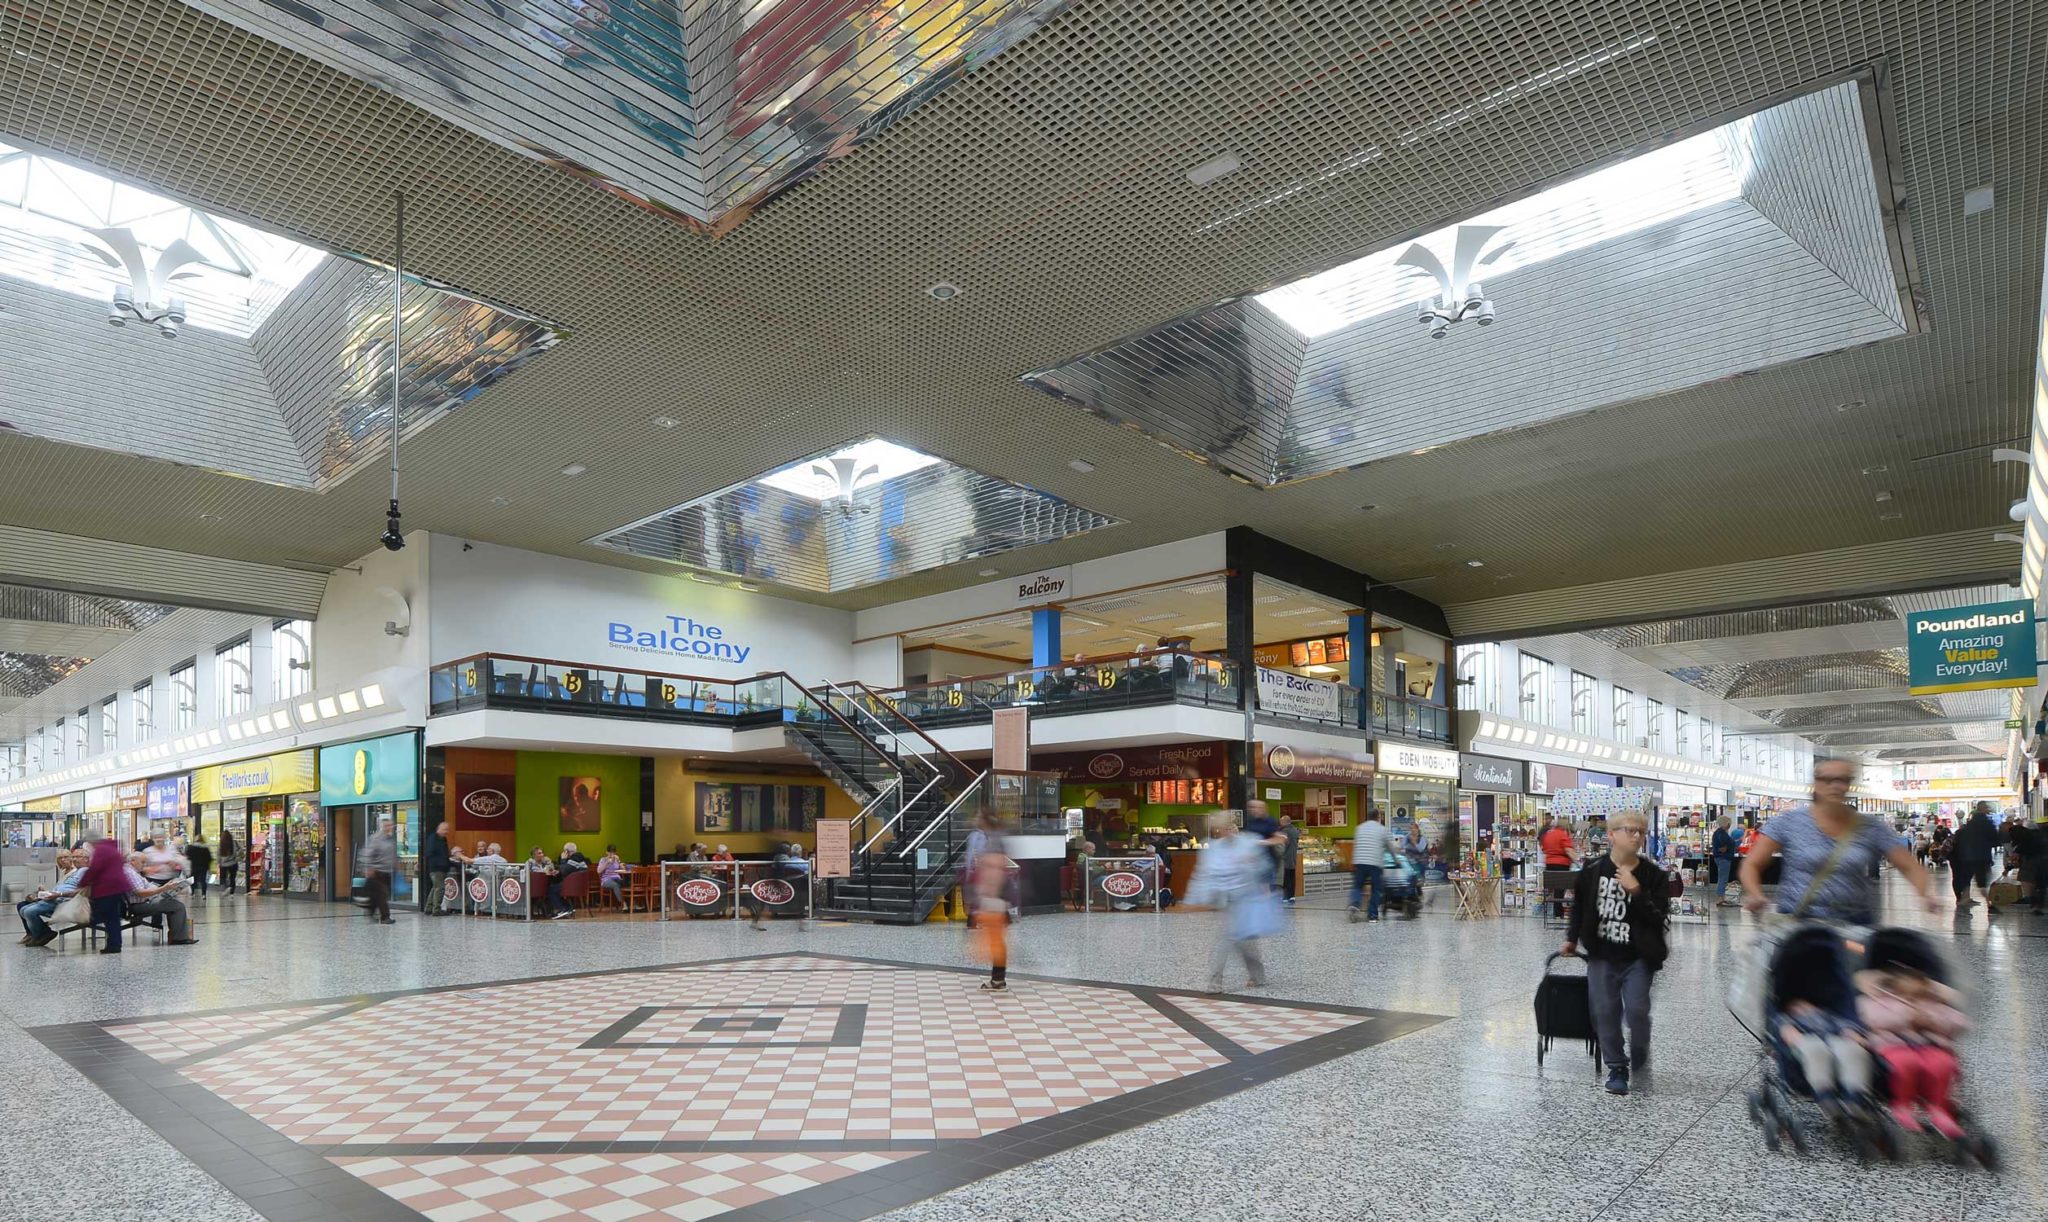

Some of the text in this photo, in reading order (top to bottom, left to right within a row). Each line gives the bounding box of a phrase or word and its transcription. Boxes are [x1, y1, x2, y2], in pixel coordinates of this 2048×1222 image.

[1037, 575, 1050, 584] The
[1019, 579, 1065, 598] Balcony
[666, 615, 722, 639] The
[1916, 610, 2025, 634] Poundland
[609, 622, 750, 664] Balcony
[1938, 634, 2004, 651] Amazing
[608, 641, 734, 664] Serving Delicious Home Made Food
[1254, 654, 1278, 664] cony
[1945, 648, 1999, 663] Value
[1936, 658, 2008, 677] Everyday!
[1259, 668, 1334, 698] The Balcony
[1272, 688, 1282, 698] For
[1282, 691, 1295, 703] every
[1159, 747, 1211, 760] Fresh Food
[1399, 751, 1456, 769] EDEN MOBILITY
[222, 766, 269, 790] TheWorks.co.uk
[1129, 764, 1184, 777] Served Daily
[1473, 764, 1513, 786] Scentiments
[470, 794, 495, 805] Coffee
[472, 804, 497, 815] Delight
[684, 883, 706, 893] Coffee
[1108, 877, 1130, 886] Coffee
[1110, 884, 1132, 895] Delight
[1598, 875, 1632, 903] BES
[685, 891, 708, 903] Delight
